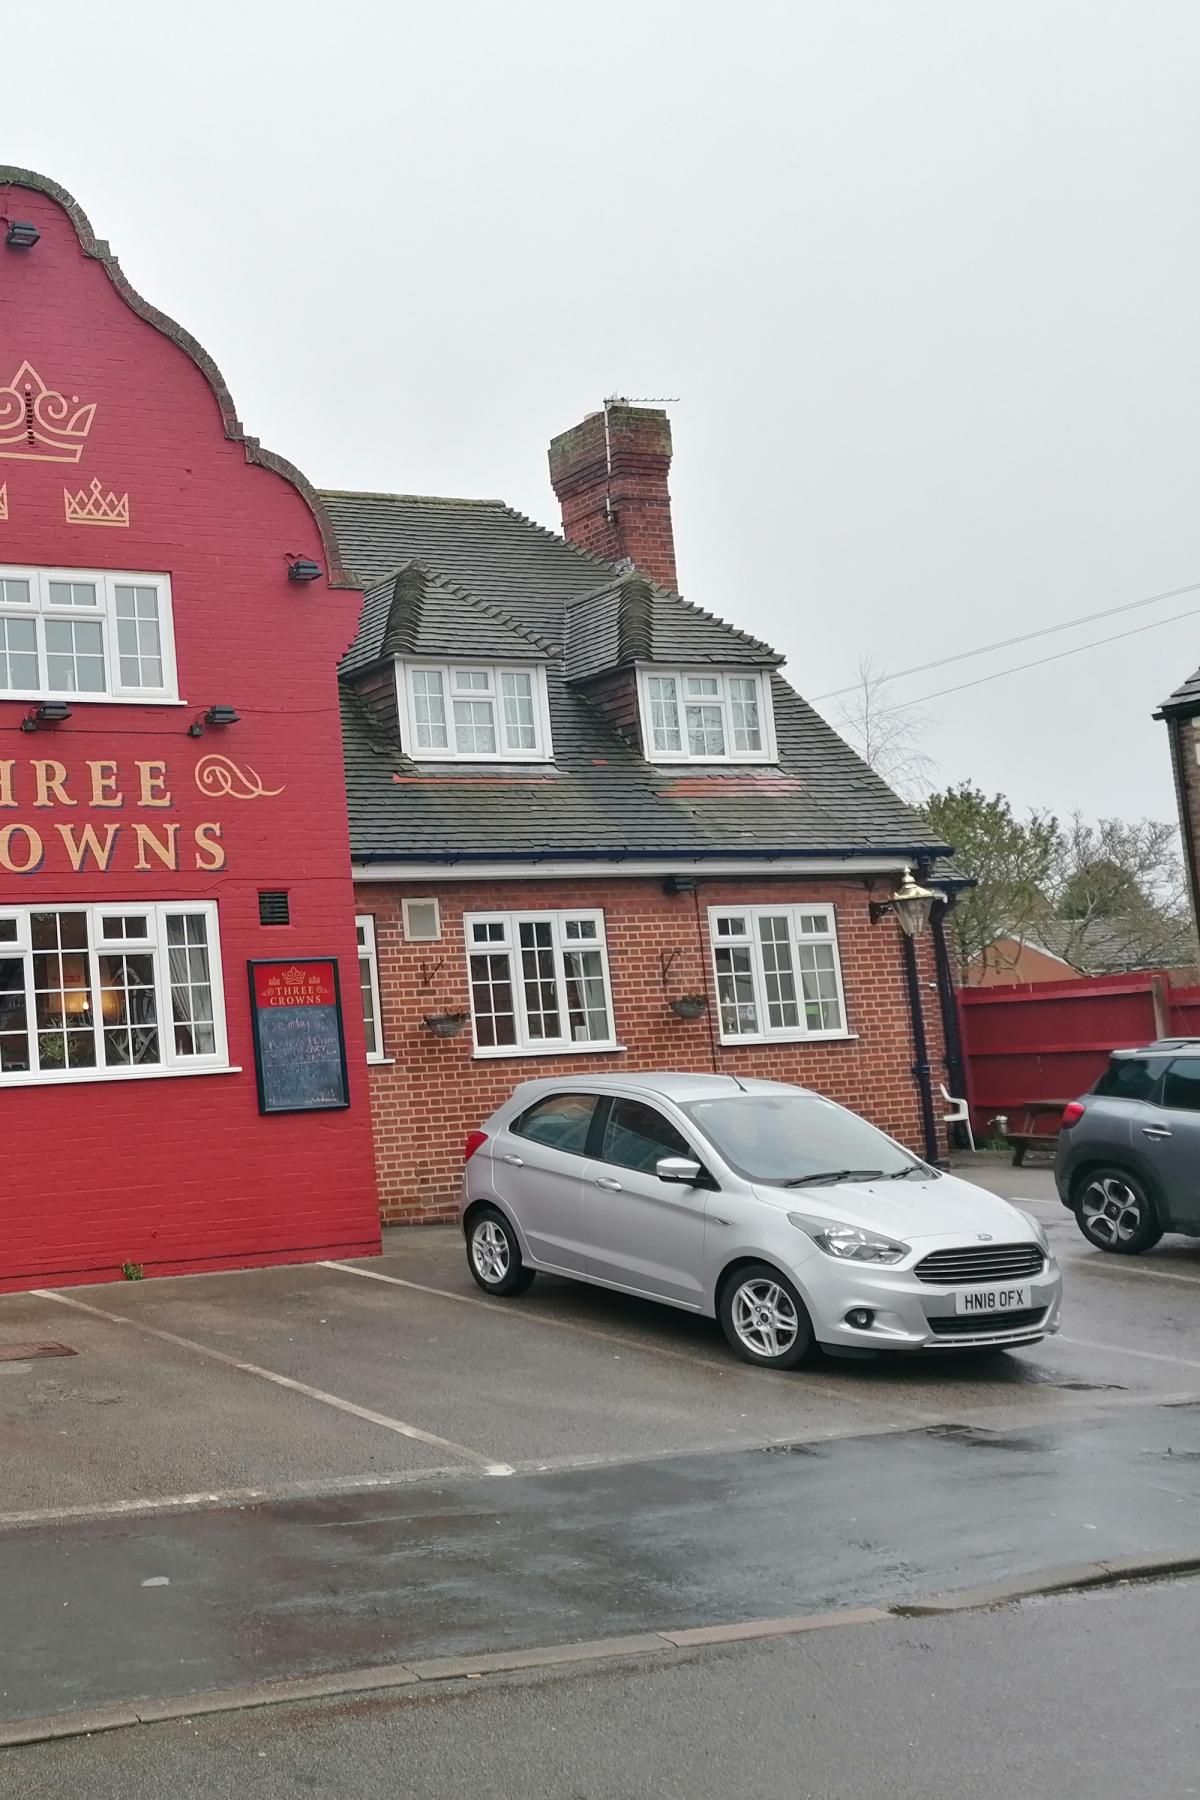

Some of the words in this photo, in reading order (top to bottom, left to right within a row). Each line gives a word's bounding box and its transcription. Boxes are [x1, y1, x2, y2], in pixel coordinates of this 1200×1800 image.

[275, 986, 314, 996] THREE
[270, 995, 321, 1006] CROWNS
[965, 1292, 995, 1310] HN18
[1000, 1289, 1023, 1307] OFX
